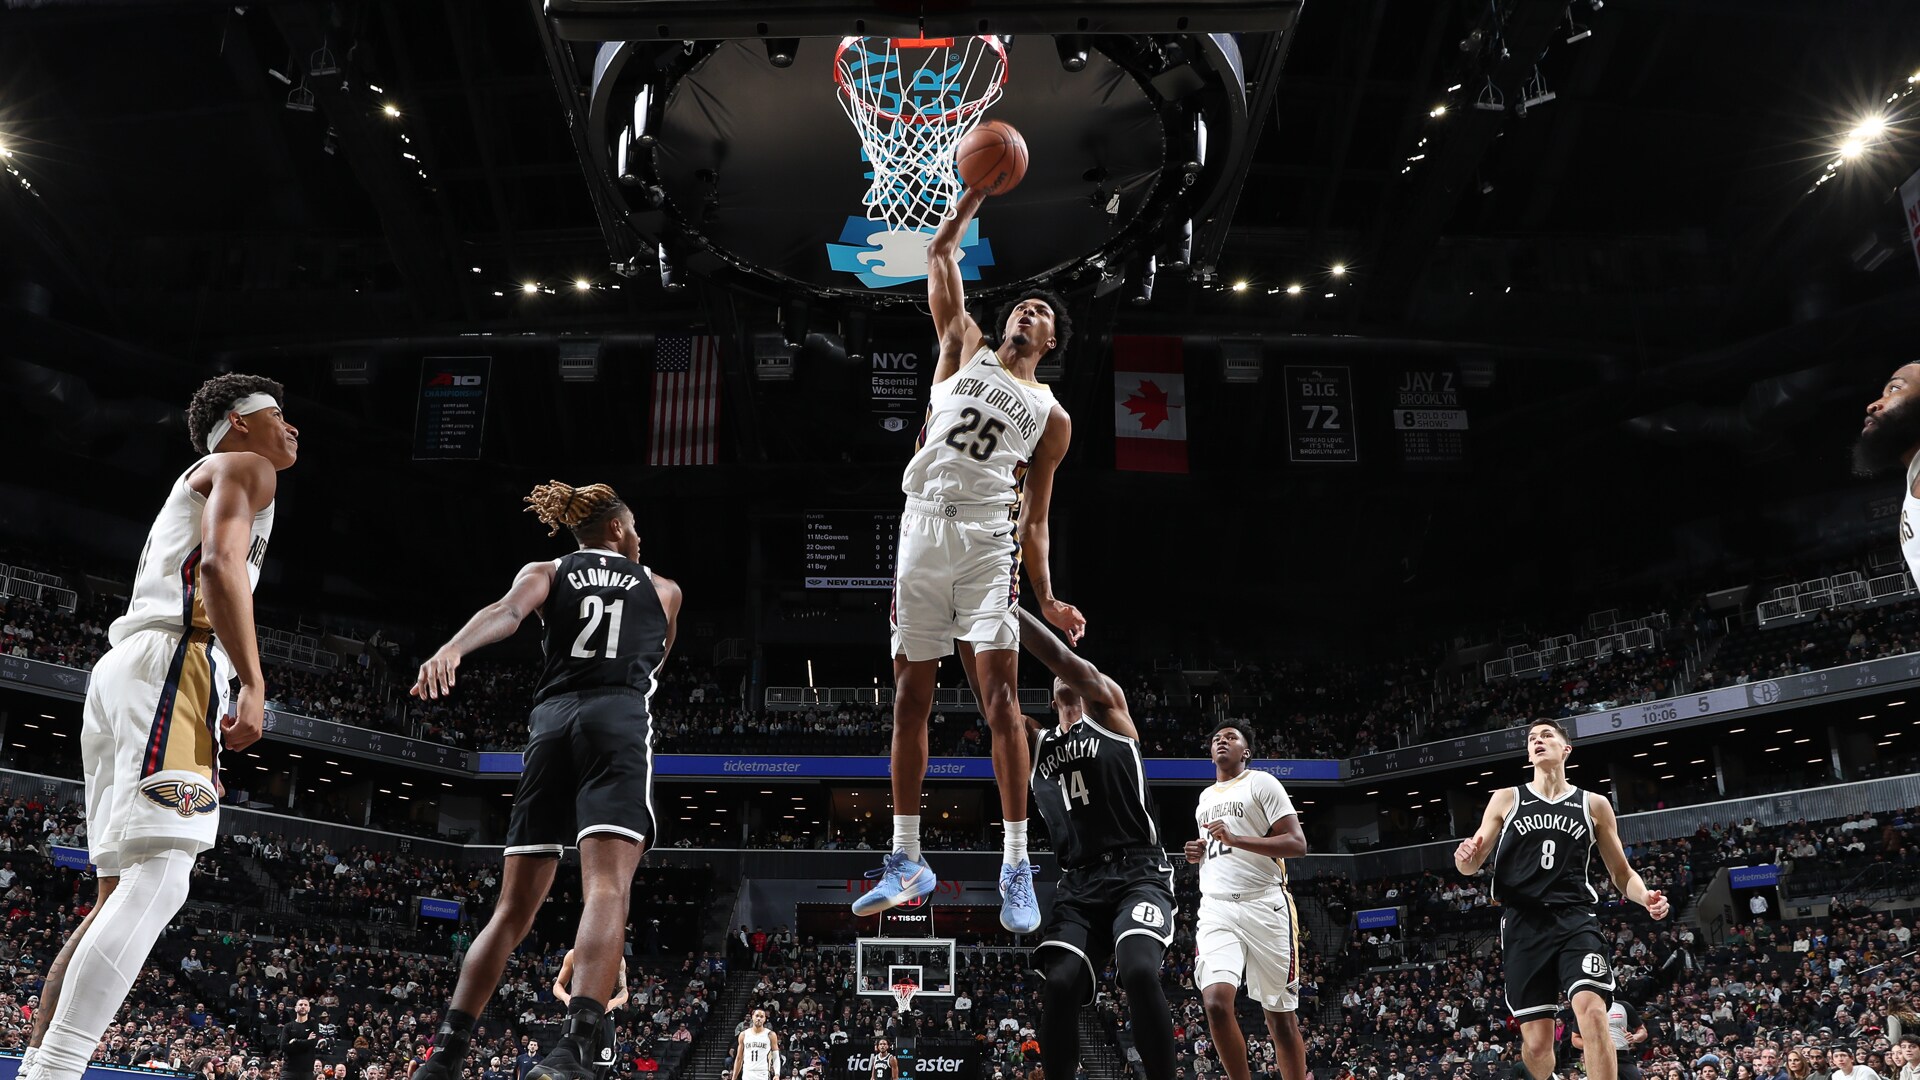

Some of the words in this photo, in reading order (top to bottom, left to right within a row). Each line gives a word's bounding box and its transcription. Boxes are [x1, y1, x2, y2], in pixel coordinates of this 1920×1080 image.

[872, 352, 918, 370] NYC
[871, 376, 918, 386] Essential
[1399, 371, 1435, 392] JAY
[1442, 371, 1456, 392] Z
[425, 390, 483, 398] CHAMPIONSHIP
[872, 386, 914, 395] Workers
[1302, 383, 1338, 397] B.I.G.
[1400, 393, 1457, 405] BROOKLYN
[951, 378, 989, 398] NEW
[985, 388, 1038, 441] ORLEANS
[1417, 412, 1439, 420] SOLD
[1441, 412, 1458, 420] OUT
[1301, 405, 1341, 429] 72
[1403, 411, 1415, 427] 8
[1417, 420, 1449, 428] SHOWS
[945, 406, 1006, 462] 25
[814, 543, 836, 551] Queen
[814, 553, 839, 561] Murphy
[814, 563, 828, 571] Bey
[567, 568, 641, 591] CLOWNEY
[570, 595, 624, 659] 21
[1652, 702, 1673, 710] Quarter
[1698, 697, 1710, 712] 5
[1611, 713, 1622, 728] 5
[1642, 709, 1677, 724] 10:06
[723, 760, 800, 772] ticketmaster
[888, 763, 965, 774] tmaster
[1058, 770, 1090, 811] 14
[1211, 802, 1243, 820] ORLEANS
[1513, 813, 1587, 841] BROOKLYN
[1540, 839, 1556, 870] 8
[423, 904, 457, 914] ticketmaster
[1360, 915, 1395, 924] ticketmaster
[751, 1050, 758, 1061] 11
